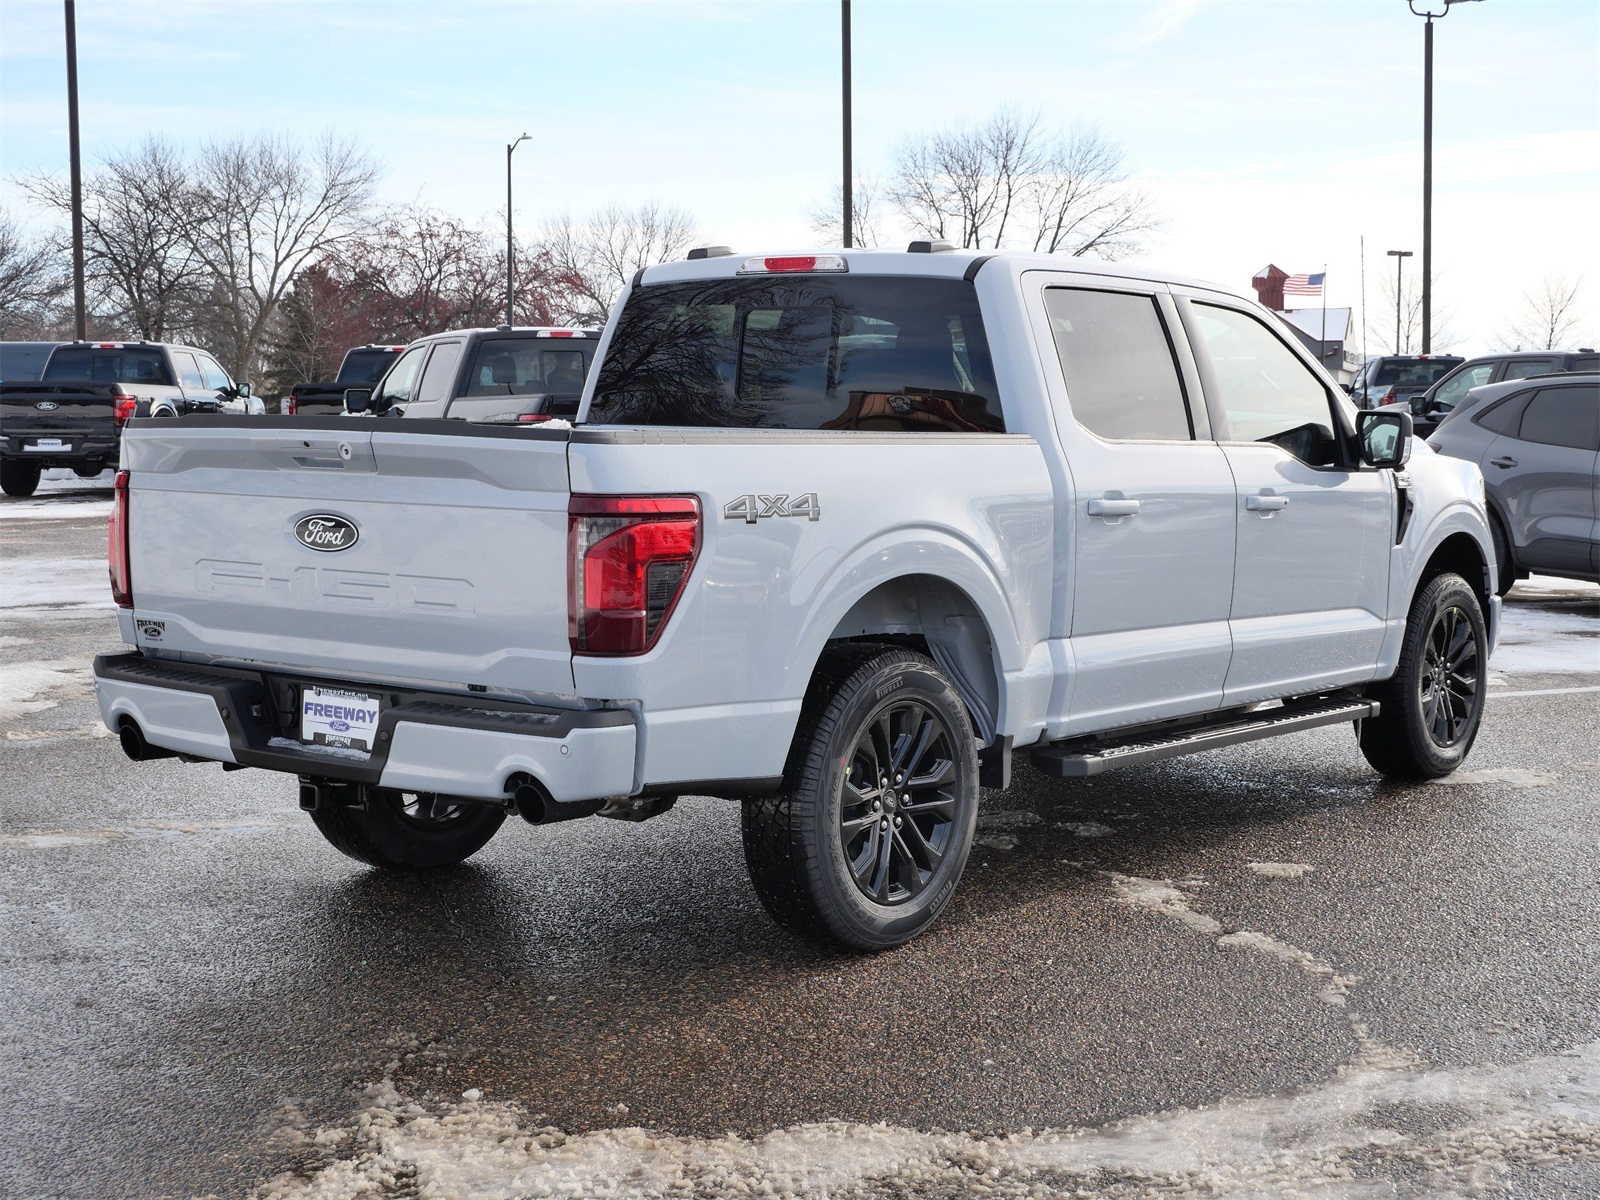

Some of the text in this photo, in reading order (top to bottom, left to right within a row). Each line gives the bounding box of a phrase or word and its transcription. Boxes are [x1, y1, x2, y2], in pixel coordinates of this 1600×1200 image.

[304, 519, 346, 545] Ford
[194, 558, 476, 618] F-150
[136, 620, 166, 631] FREEWAY
[312, 685, 369, 700] FreewayFord.net
[875, 675, 903, 700] PIRELLI
[304, 702, 377, 724] FREEWAY
[332, 721, 347, 731] Ford
[325, 734, 352, 746] FREEWAY
